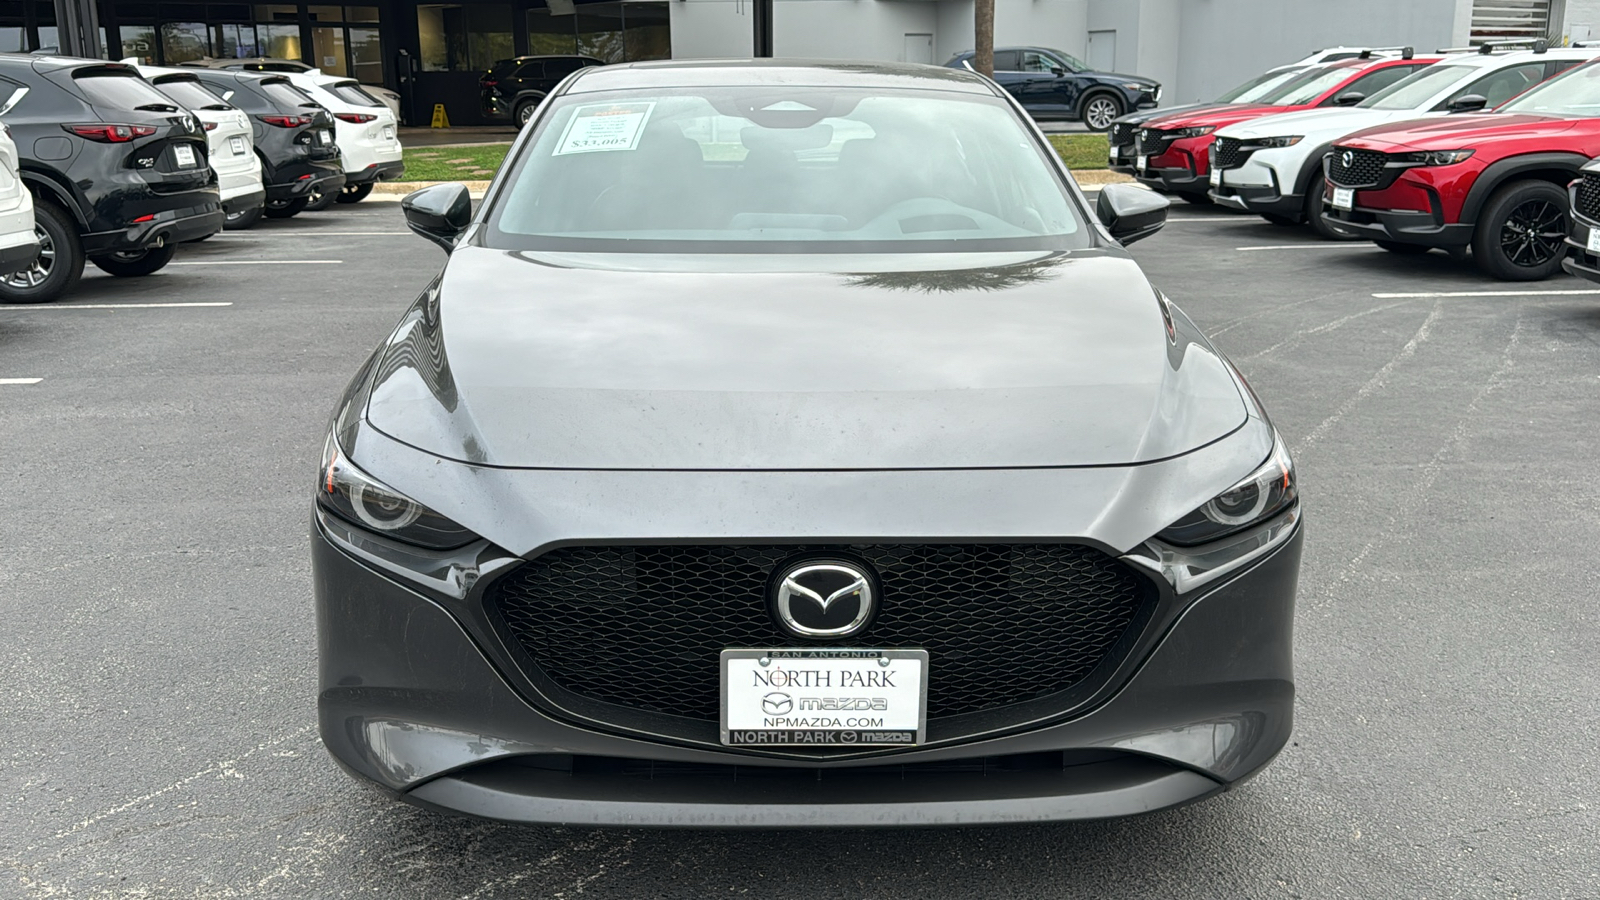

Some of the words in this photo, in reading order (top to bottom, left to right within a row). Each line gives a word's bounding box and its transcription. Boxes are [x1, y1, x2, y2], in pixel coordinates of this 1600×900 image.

[752, 669, 831, 688] NORTH
[840, 670, 897, 688] PARK
[799, 697, 888, 711] mazda
[763, 717, 884, 727] NPMAZDA.COM
[733, 731, 789, 743] NORTH
[793, 731, 836, 743] PARK
[861, 732, 912, 742] mazda
